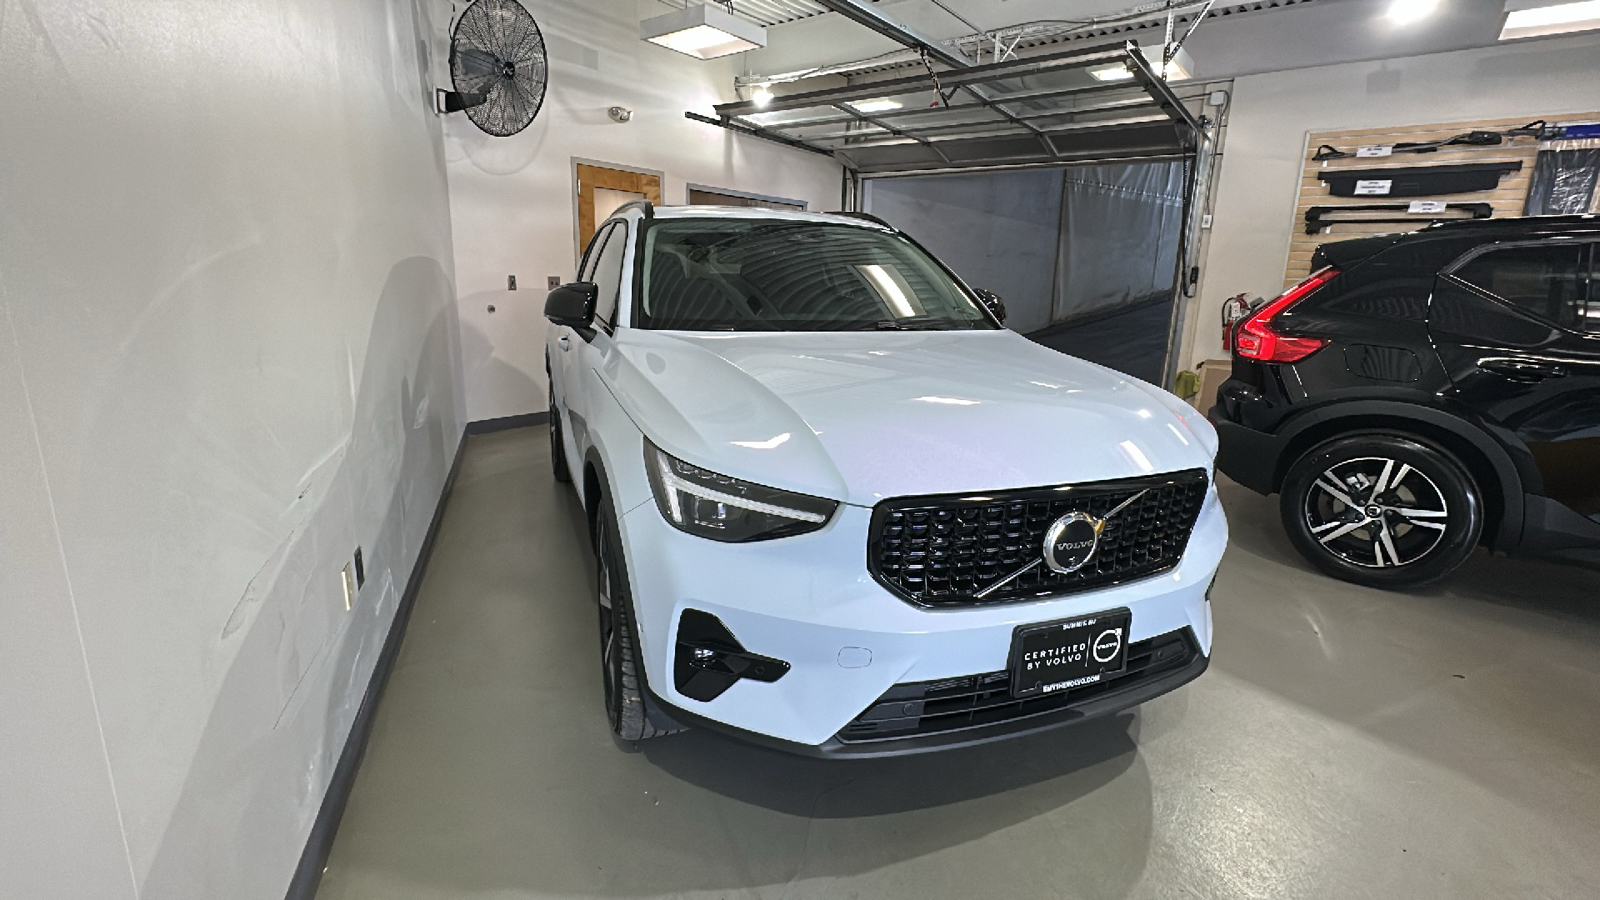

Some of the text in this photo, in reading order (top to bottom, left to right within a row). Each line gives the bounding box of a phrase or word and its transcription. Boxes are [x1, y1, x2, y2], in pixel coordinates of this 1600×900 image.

[1056, 539, 1093, 551] VOLVO
[1024, 643, 1086, 661] CERTIFIED
[1027, 654, 1082, 670] BY VOLVO
